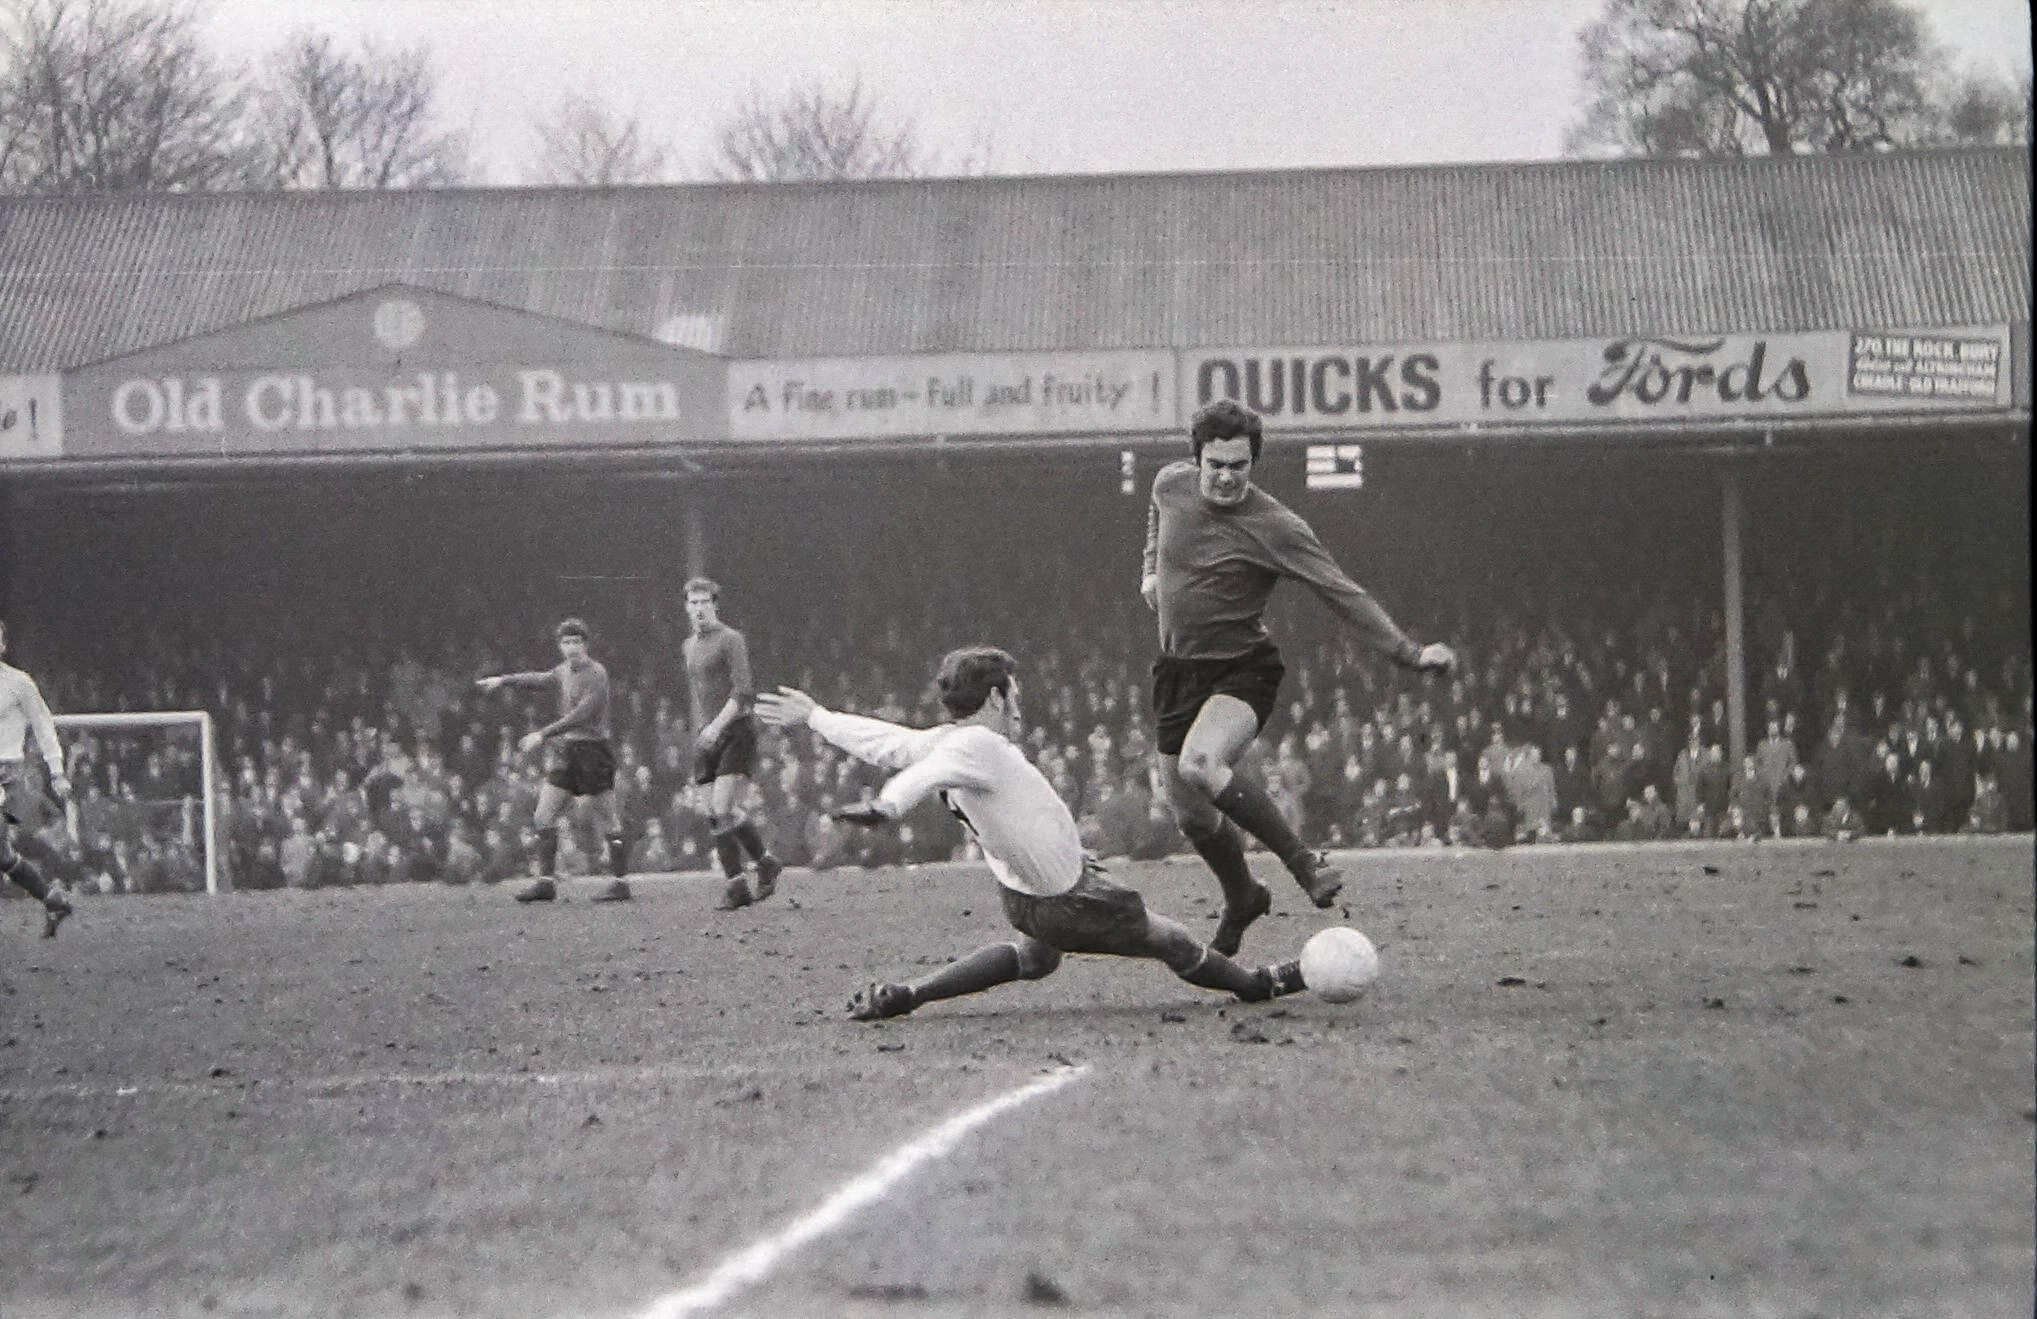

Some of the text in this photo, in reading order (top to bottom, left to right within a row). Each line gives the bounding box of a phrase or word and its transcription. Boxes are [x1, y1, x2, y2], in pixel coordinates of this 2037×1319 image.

[111, 367, 682, 434] Old Charlie Rum
[743, 382, 772, 413] A
[1199, 334, 1812, 415] QUICKS for Fords
